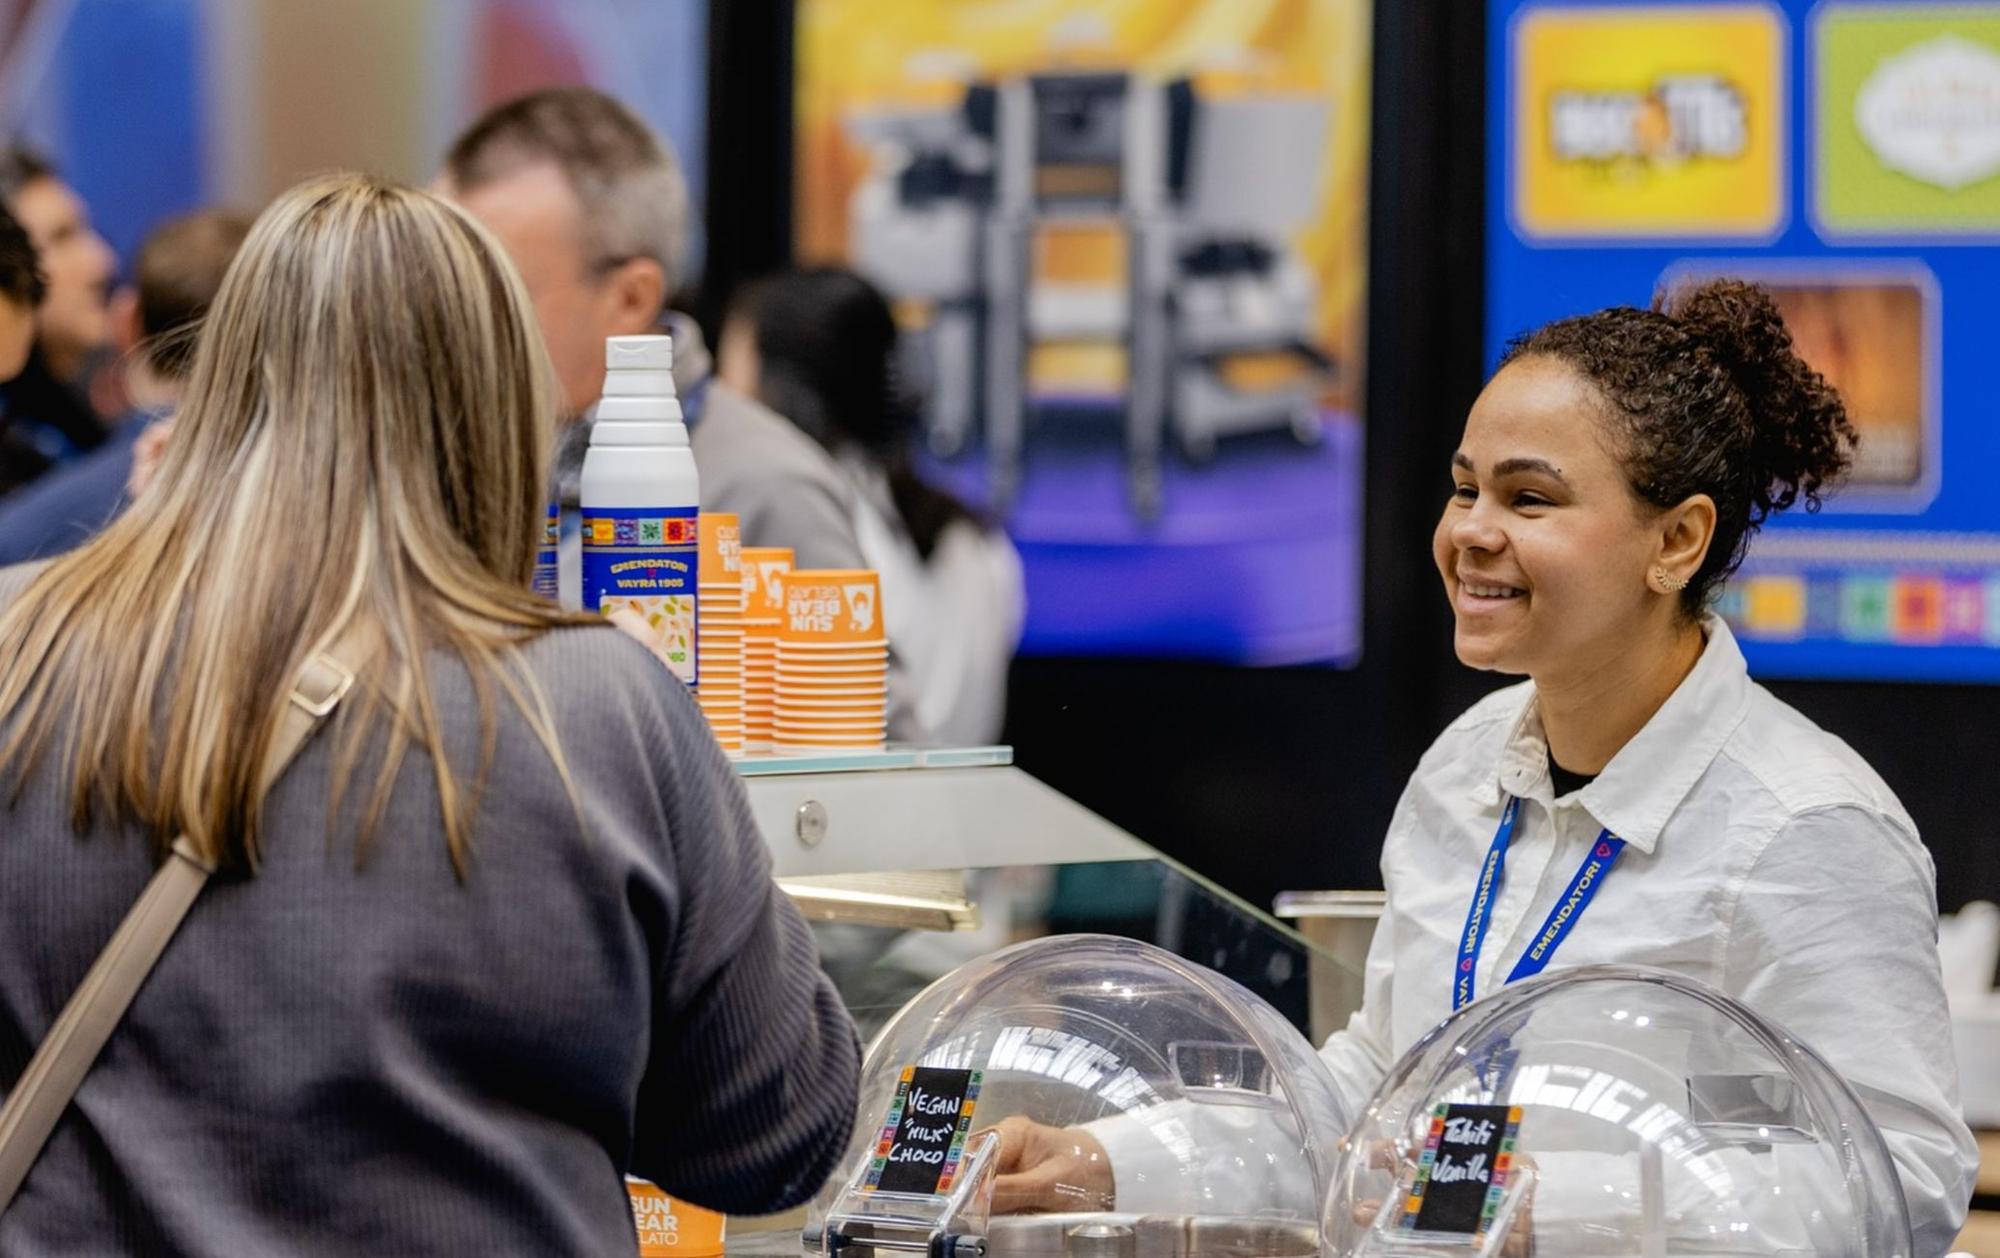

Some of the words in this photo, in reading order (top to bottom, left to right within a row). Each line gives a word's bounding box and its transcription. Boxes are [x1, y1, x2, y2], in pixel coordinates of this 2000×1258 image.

[616, 579, 657, 588] VAYRA
[788, 600, 841, 616] BEAR
[790, 615, 834, 633] SUN
[1463, 850, 1499, 954] EMENDATORI
[1529, 861, 1601, 961] EMENDATORI
[908, 1087, 960, 1115] VEGAN
[888, 1142, 944, 1164] CHOCO
[634, 1213, 679, 1231] EAR
[638, 1232, 680, 1246] LATO
